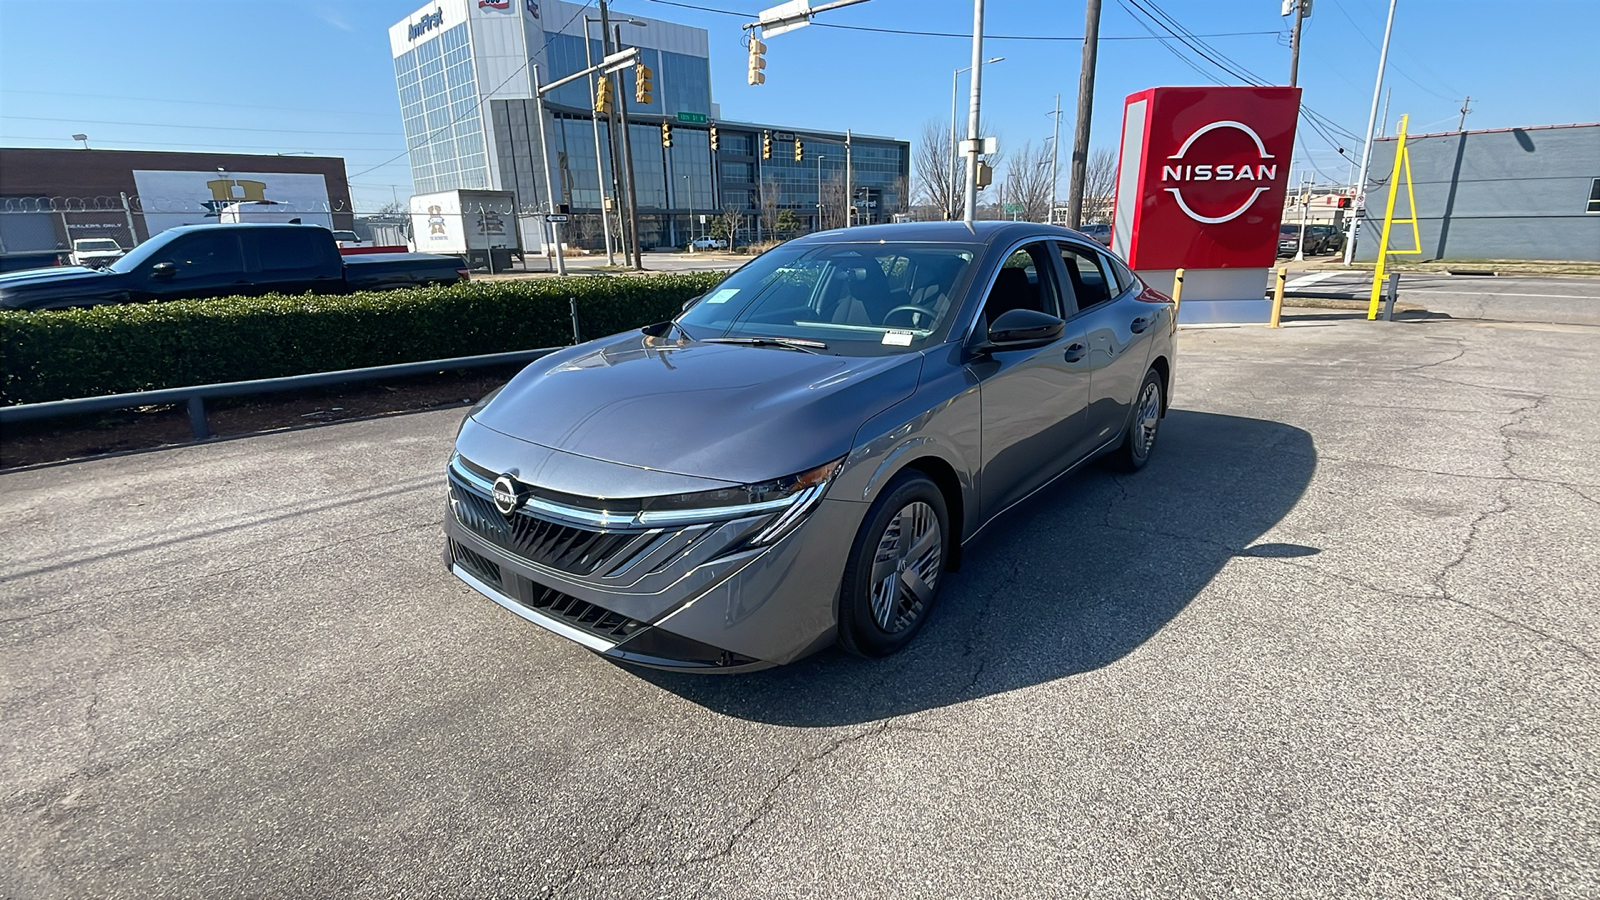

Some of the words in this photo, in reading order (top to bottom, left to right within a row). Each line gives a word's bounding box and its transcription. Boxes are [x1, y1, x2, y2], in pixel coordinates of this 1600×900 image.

[408, 6, 443, 42] AmFirst
[1162, 164, 1277, 181] NISSAN
[493, 490, 517, 505] SSAN
